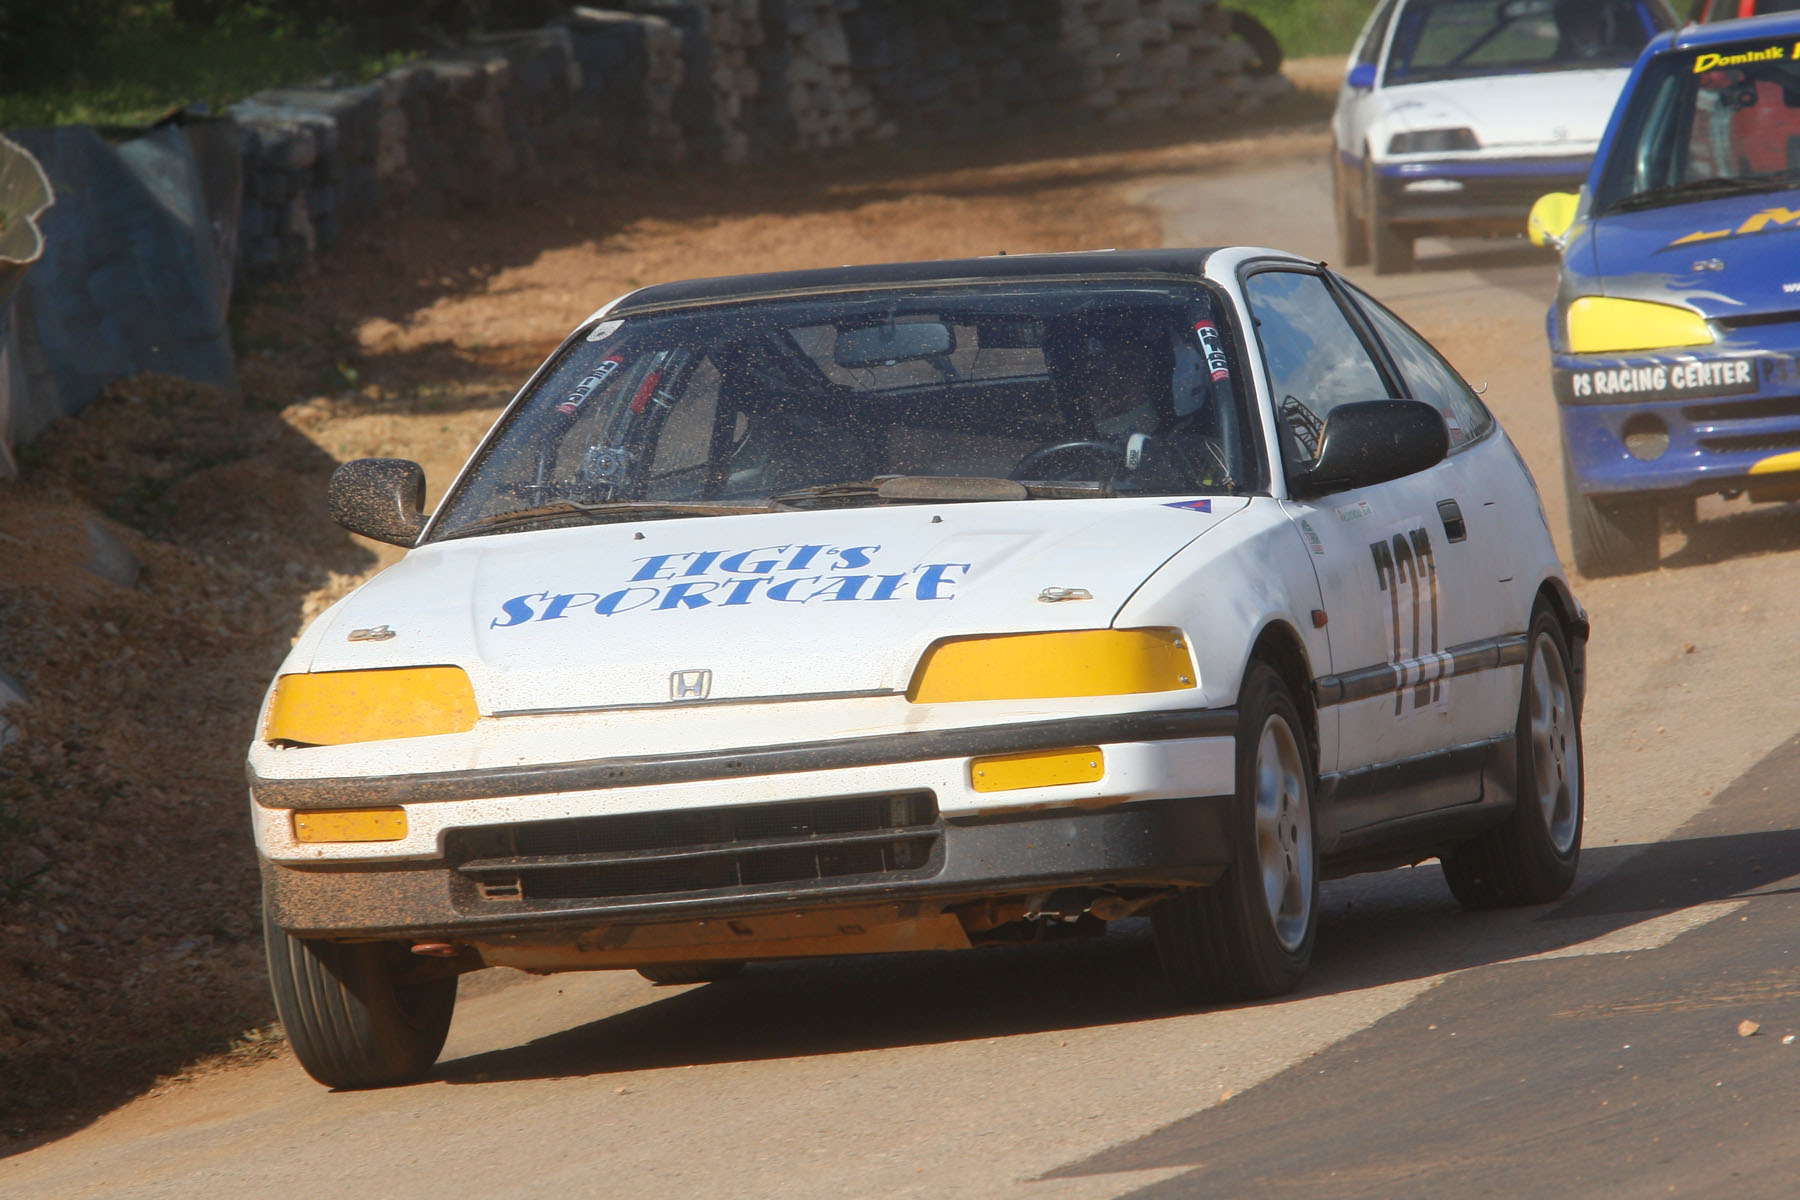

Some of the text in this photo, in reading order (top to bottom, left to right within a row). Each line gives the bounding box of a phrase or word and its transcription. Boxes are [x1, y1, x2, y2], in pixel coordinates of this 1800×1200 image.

[1693, 46, 1784, 74] Dominik
[1573, 360, 1751, 397] PS RACING CENTER
